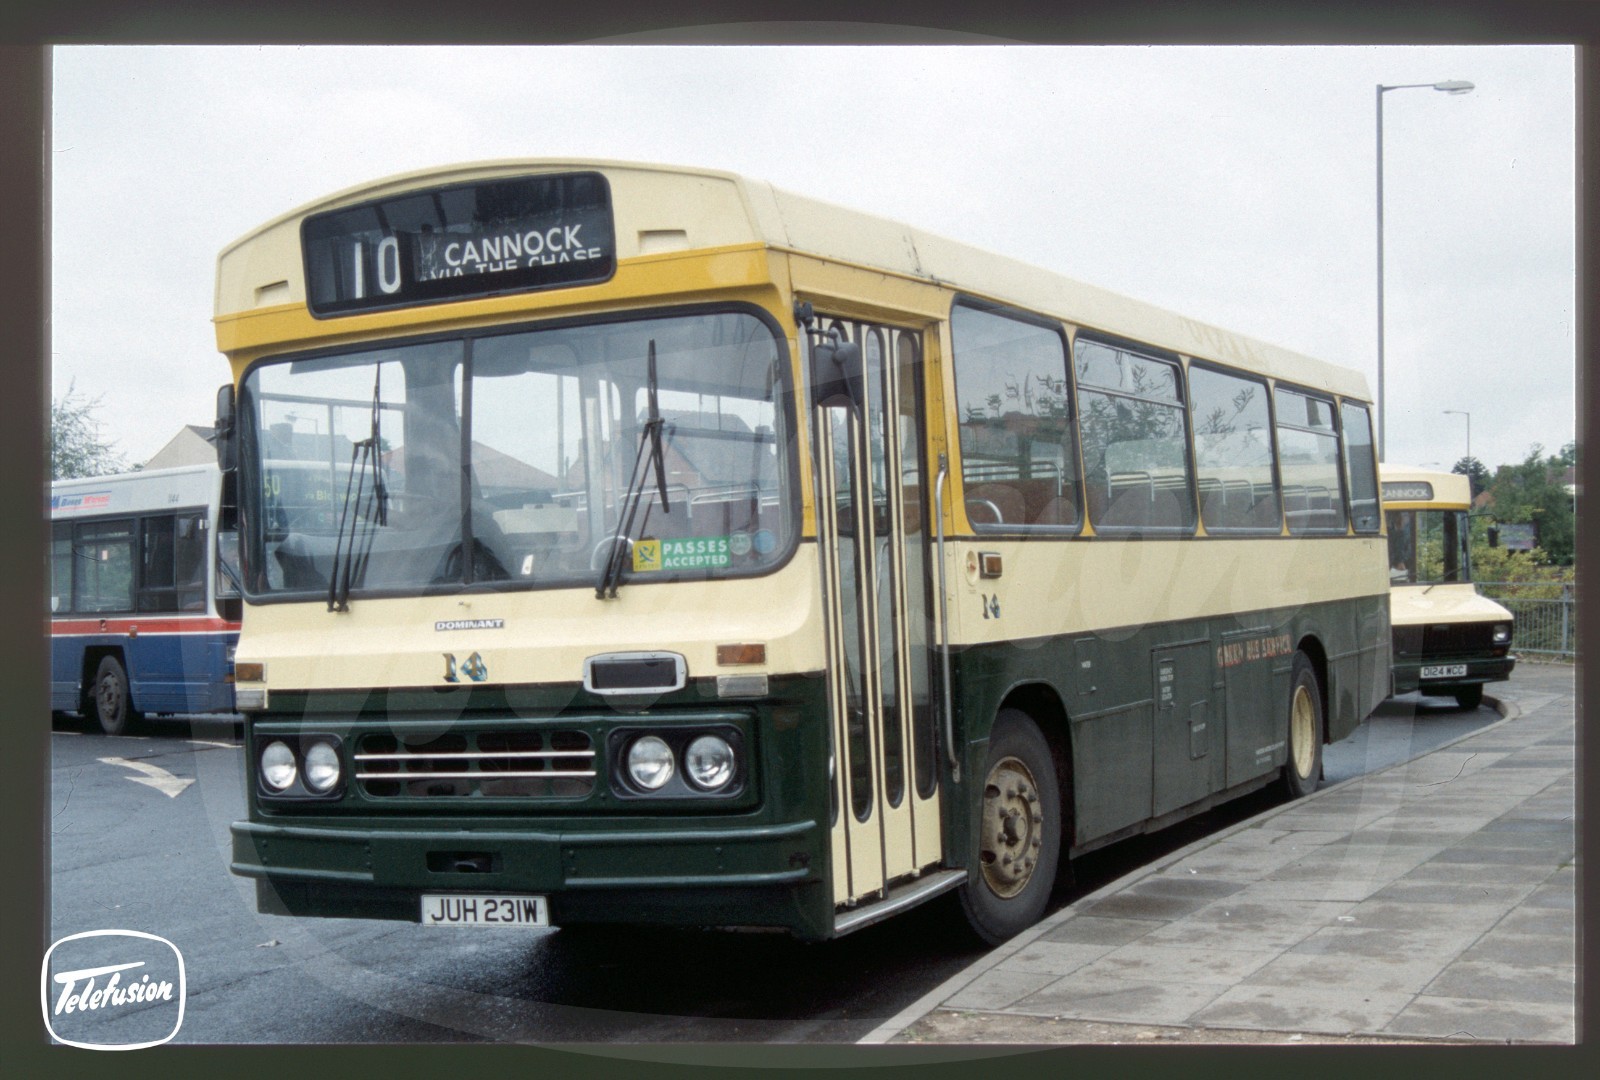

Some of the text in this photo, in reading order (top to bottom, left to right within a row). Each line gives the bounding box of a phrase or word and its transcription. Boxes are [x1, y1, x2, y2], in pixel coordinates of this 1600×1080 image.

[444, 224, 583, 267] CANNOCK
[354, 236, 400, 298] 10
[663, 540, 727, 555] PASSES
[664, 555, 727, 567] ACCEPTED
[981, 593, 1001, 620] 14
[436, 620, 503, 630] DOMINANT
[442, 651, 488, 683] 14
[1423, 667, 1444, 676] D124
[431, 898, 537, 923] JUH 231W
